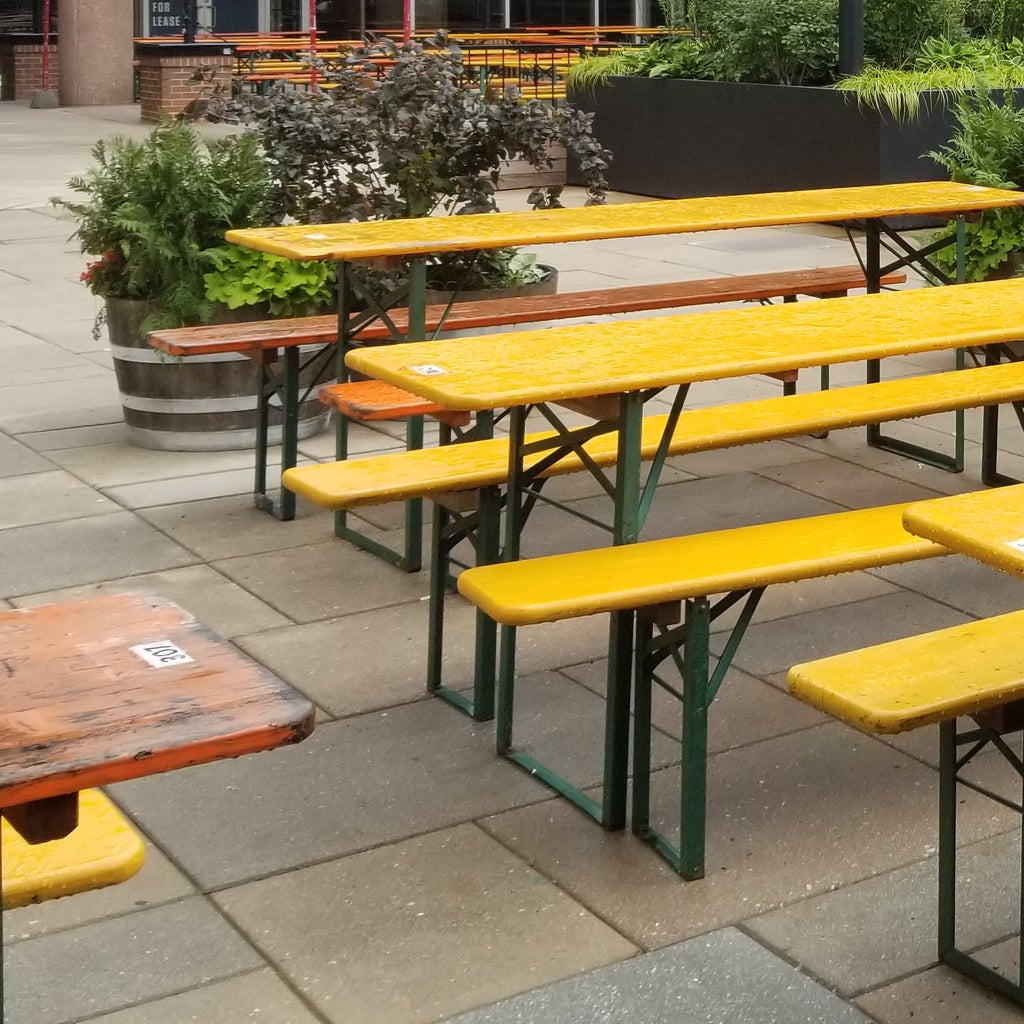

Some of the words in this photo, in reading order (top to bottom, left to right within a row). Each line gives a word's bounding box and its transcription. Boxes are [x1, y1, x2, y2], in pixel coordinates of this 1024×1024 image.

[152, 2, 170, 13] FOR
[152, 16, 181, 27] LEASE
[143, 645, 186, 663] 307
